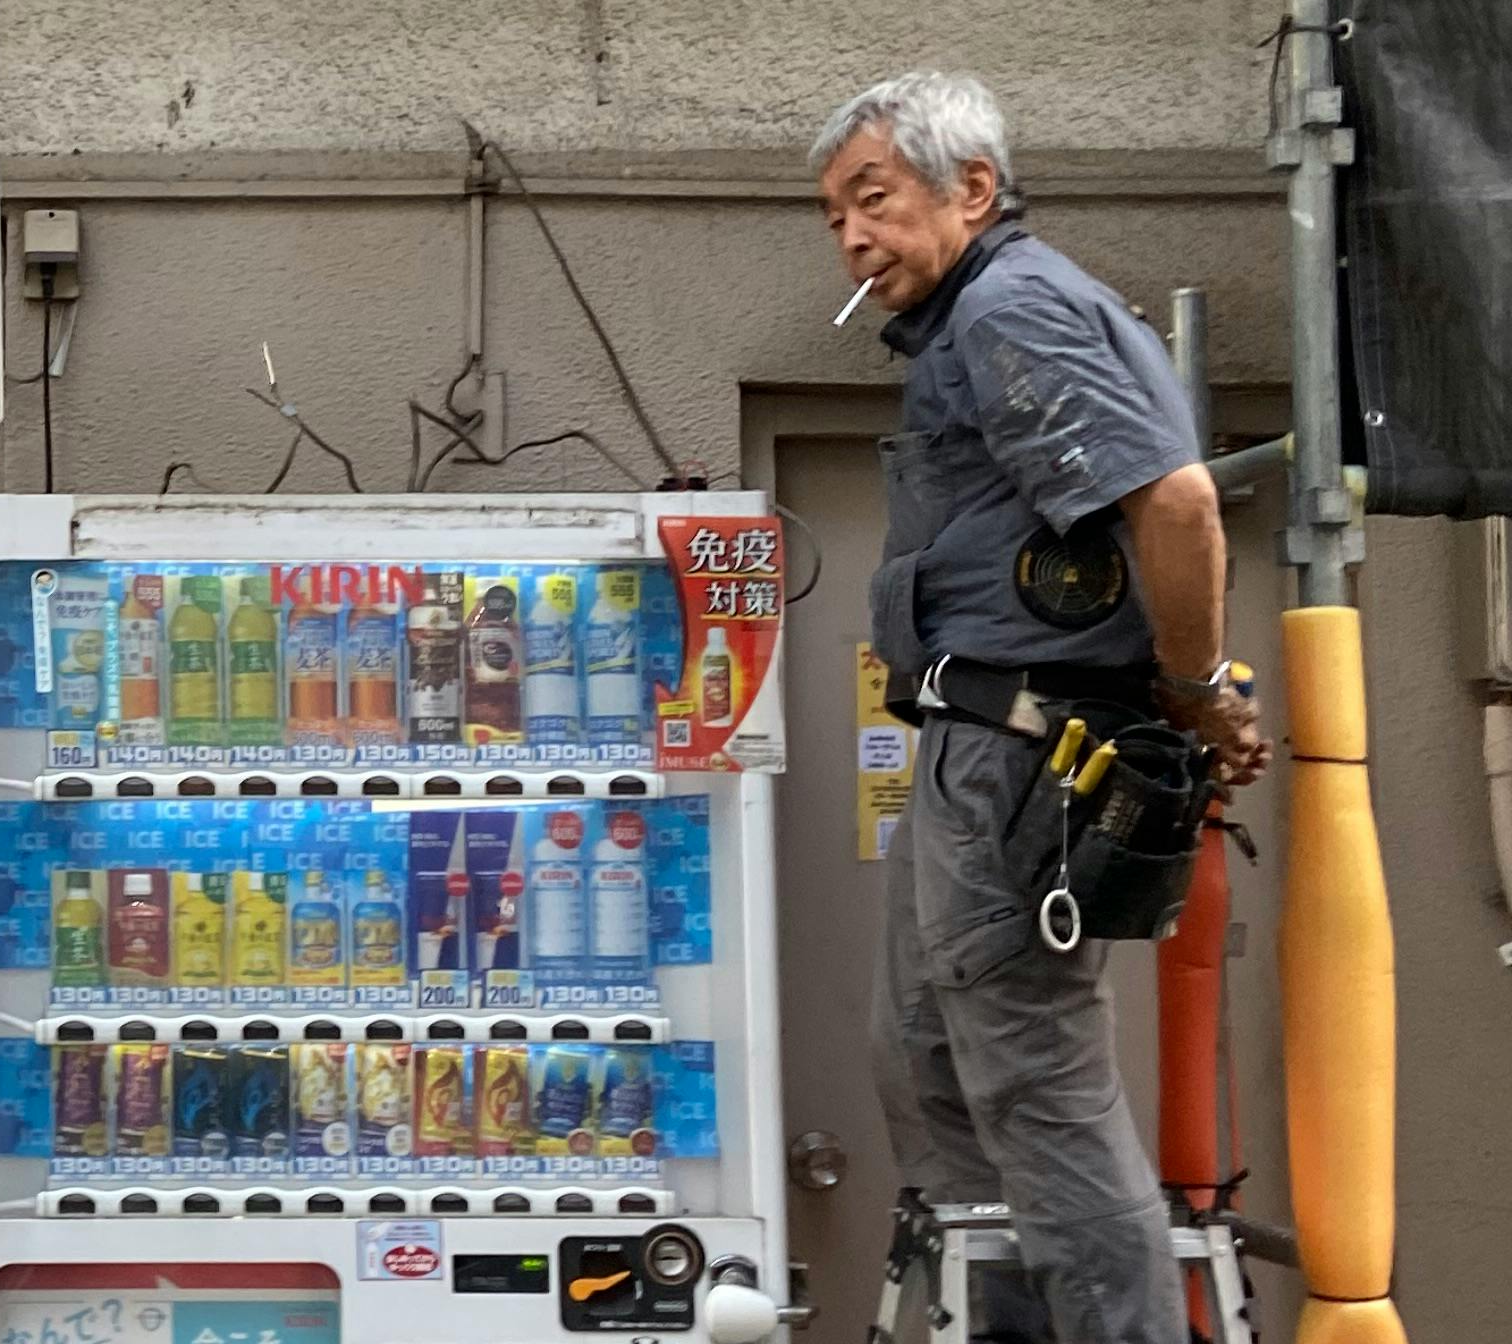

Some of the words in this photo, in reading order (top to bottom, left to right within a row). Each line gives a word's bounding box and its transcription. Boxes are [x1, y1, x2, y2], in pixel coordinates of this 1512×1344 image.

[686, 527, 778, 575] 免疫
[271, 564, 425, 605] KIRIN
[704, 581, 779, 617] 対策
